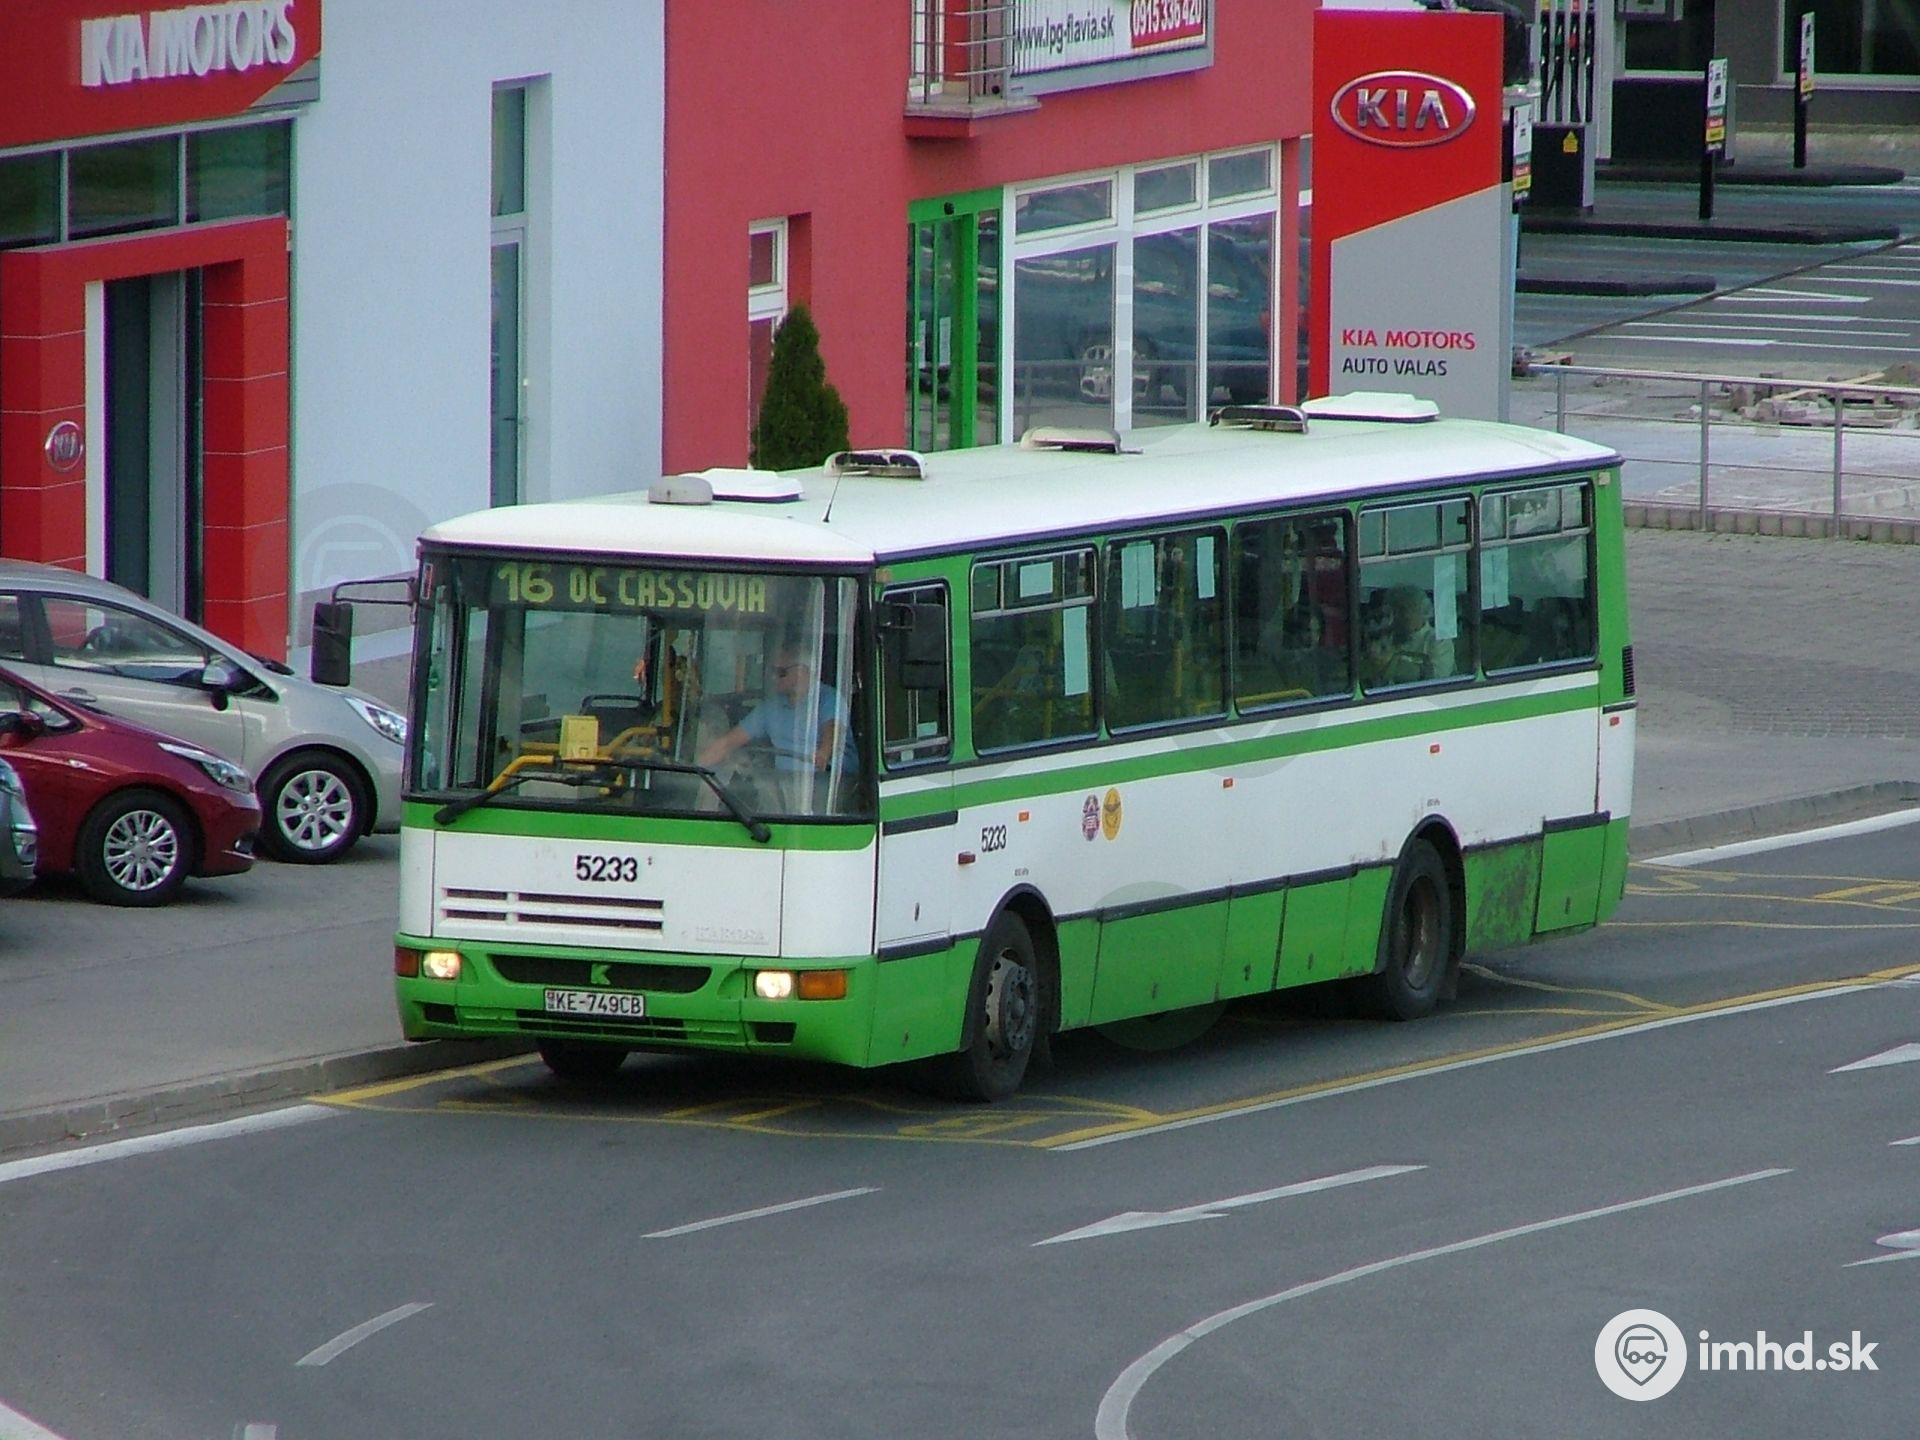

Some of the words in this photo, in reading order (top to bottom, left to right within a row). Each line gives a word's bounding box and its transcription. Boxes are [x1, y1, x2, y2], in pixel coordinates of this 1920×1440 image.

[81, 14, 148, 87] KIA
[148, 0, 296, 78] MOTORS
[1356, 88, 1450, 130] KIA
[1342, 329, 1378, 347] KIA
[1385, 330, 1476, 350] MOTORS
[1342, 357, 1388, 374] AUTO
[1393, 359, 1448, 376] VALAS
[498, 562, 554, 603] 16
[569, 567, 608, 604] OC
[618, 570, 766, 613] CASSOVIA
[981, 824, 1007, 853] 5233
[576, 854, 638, 882] 5233
[556, 993, 641, 1014] KE-749CB
